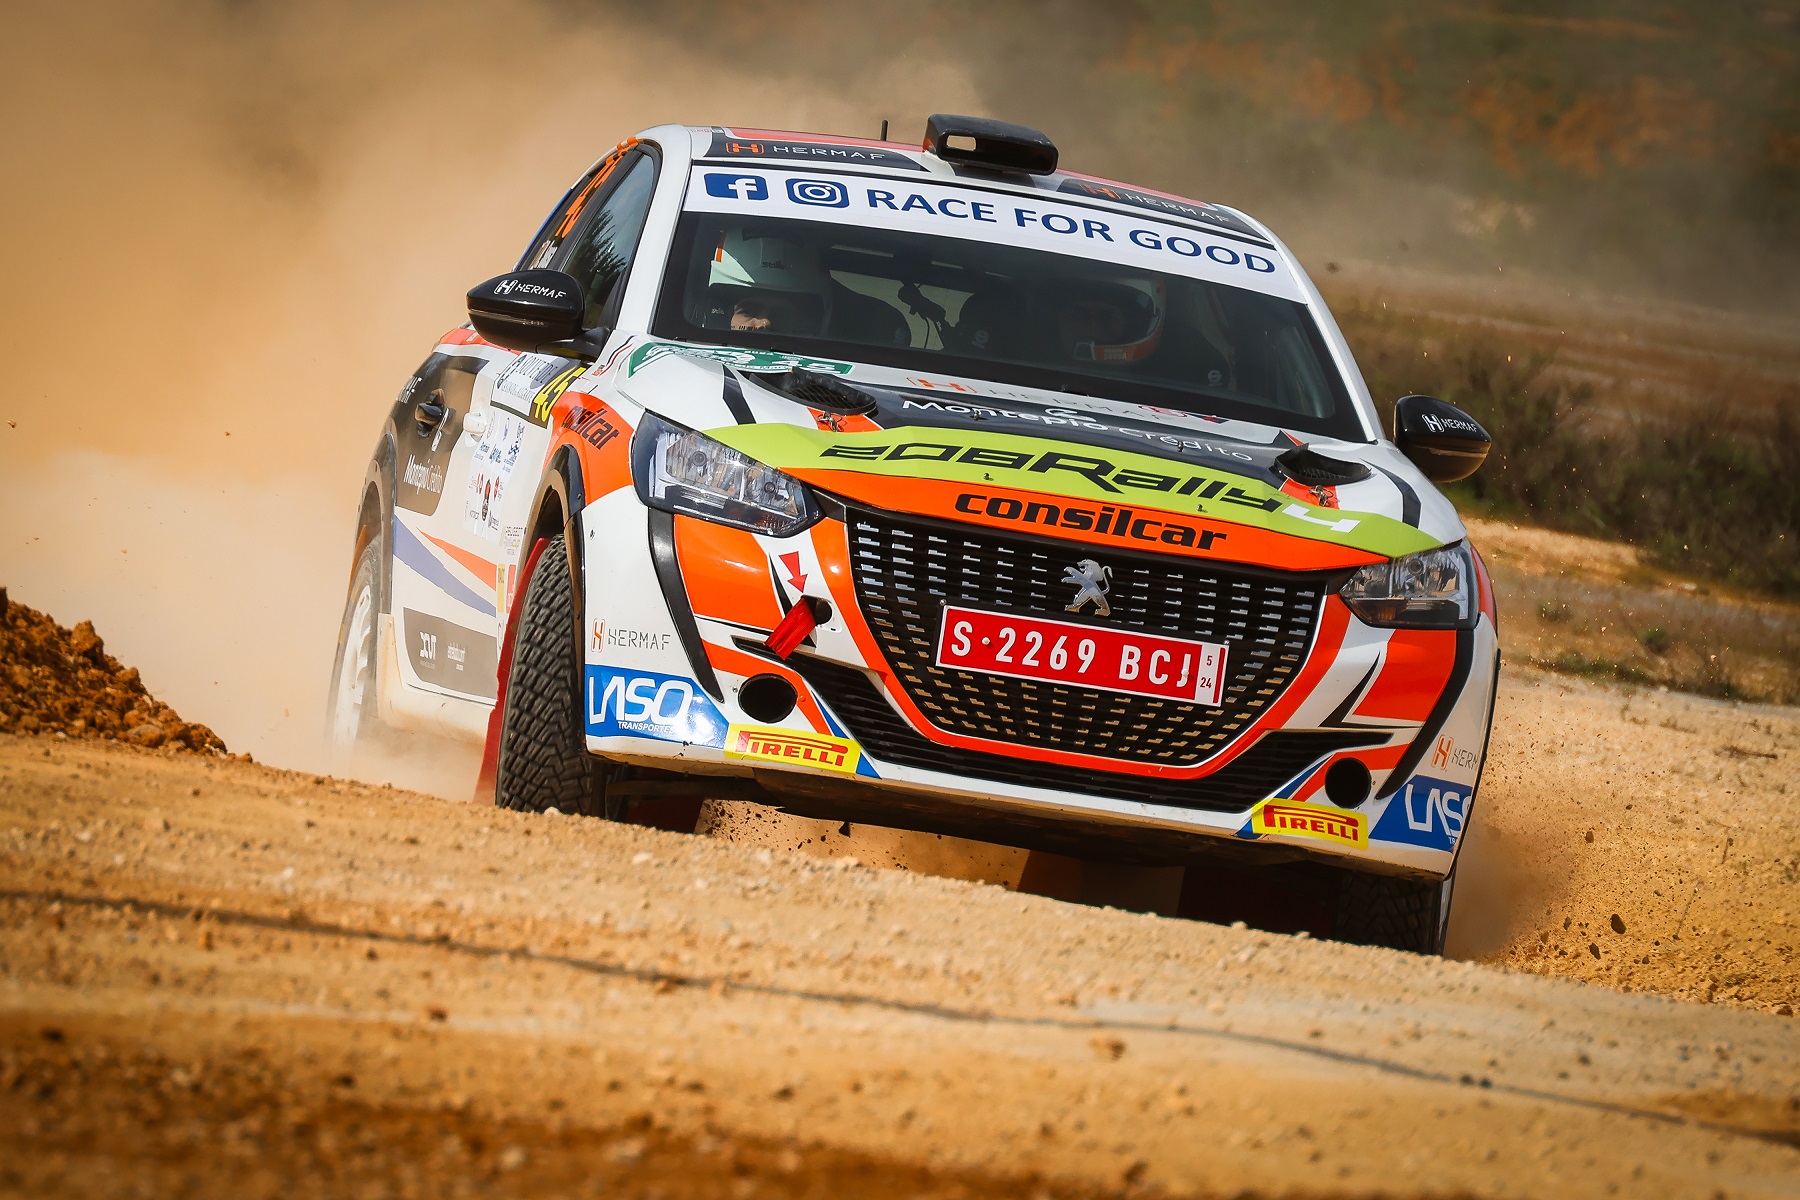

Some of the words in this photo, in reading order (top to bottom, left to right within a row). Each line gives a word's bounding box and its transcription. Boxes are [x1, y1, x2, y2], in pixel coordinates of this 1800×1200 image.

[773, 145, 886, 160] HERMAF
[1124, 192, 1231, 223] HERMAF
[866, 188, 998, 223] RACE
[1014, 207, 1115, 243] FOR
[1128, 229, 1276, 274] GOOD
[514, 282, 567, 299] HERMAF
[902, 399, 1110, 432] Montepio
[1440, 418, 1478, 433] HERMAF
[953, 492, 1229, 552] consilcar
[607, 627, 672, 652] HERMAF
[994, 626, 1097, 674] 2269
[1117, 644, 1192, 689] BCJ
[1205, 654, 1214, 668] 5
[1199, 675, 1213, 690] 24
[735, 730, 849, 768] PIRELLI
[1262, 803, 1360, 843] PIRELLI
